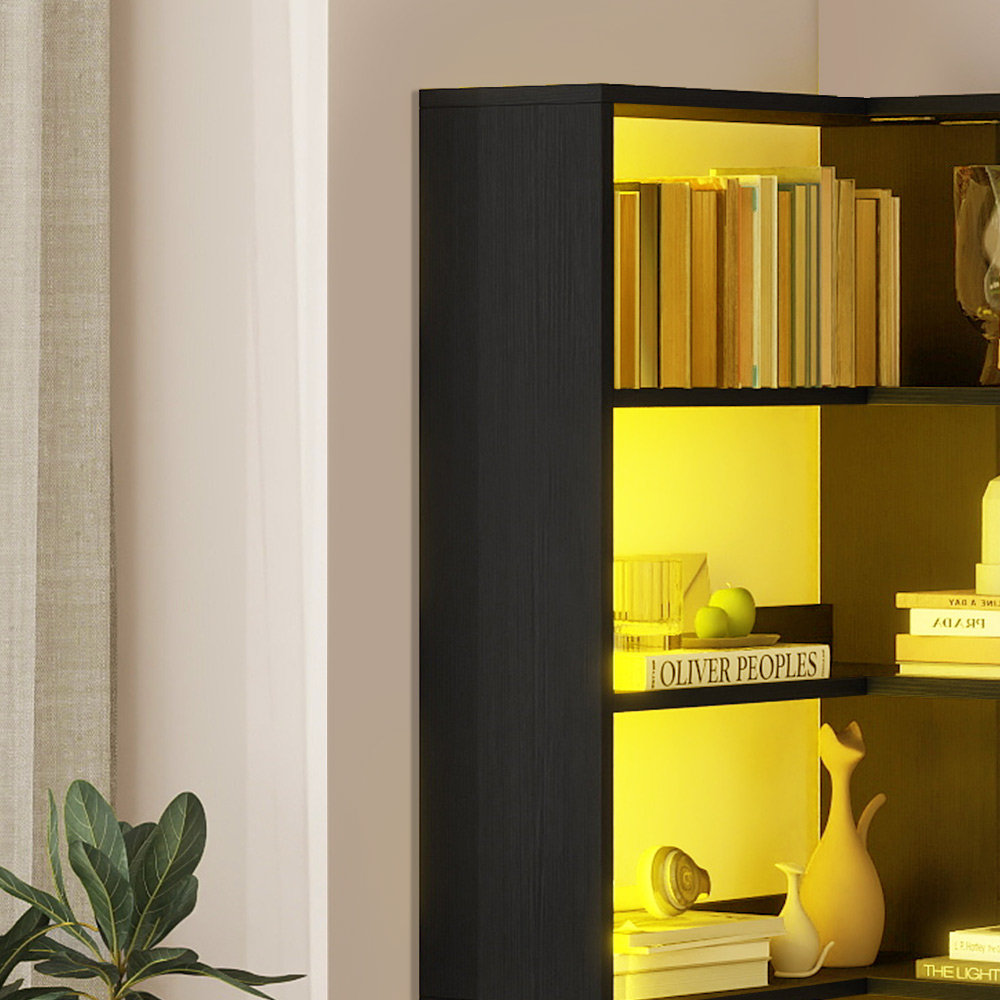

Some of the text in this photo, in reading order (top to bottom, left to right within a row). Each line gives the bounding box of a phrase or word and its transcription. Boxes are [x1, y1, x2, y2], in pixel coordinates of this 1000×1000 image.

[659, 656, 731, 688] OLIVER
[735, 650, 818, 682] PEOPLES
[923, 964, 954, 978] THE
[957, 966, 1000, 982] LIGHT
